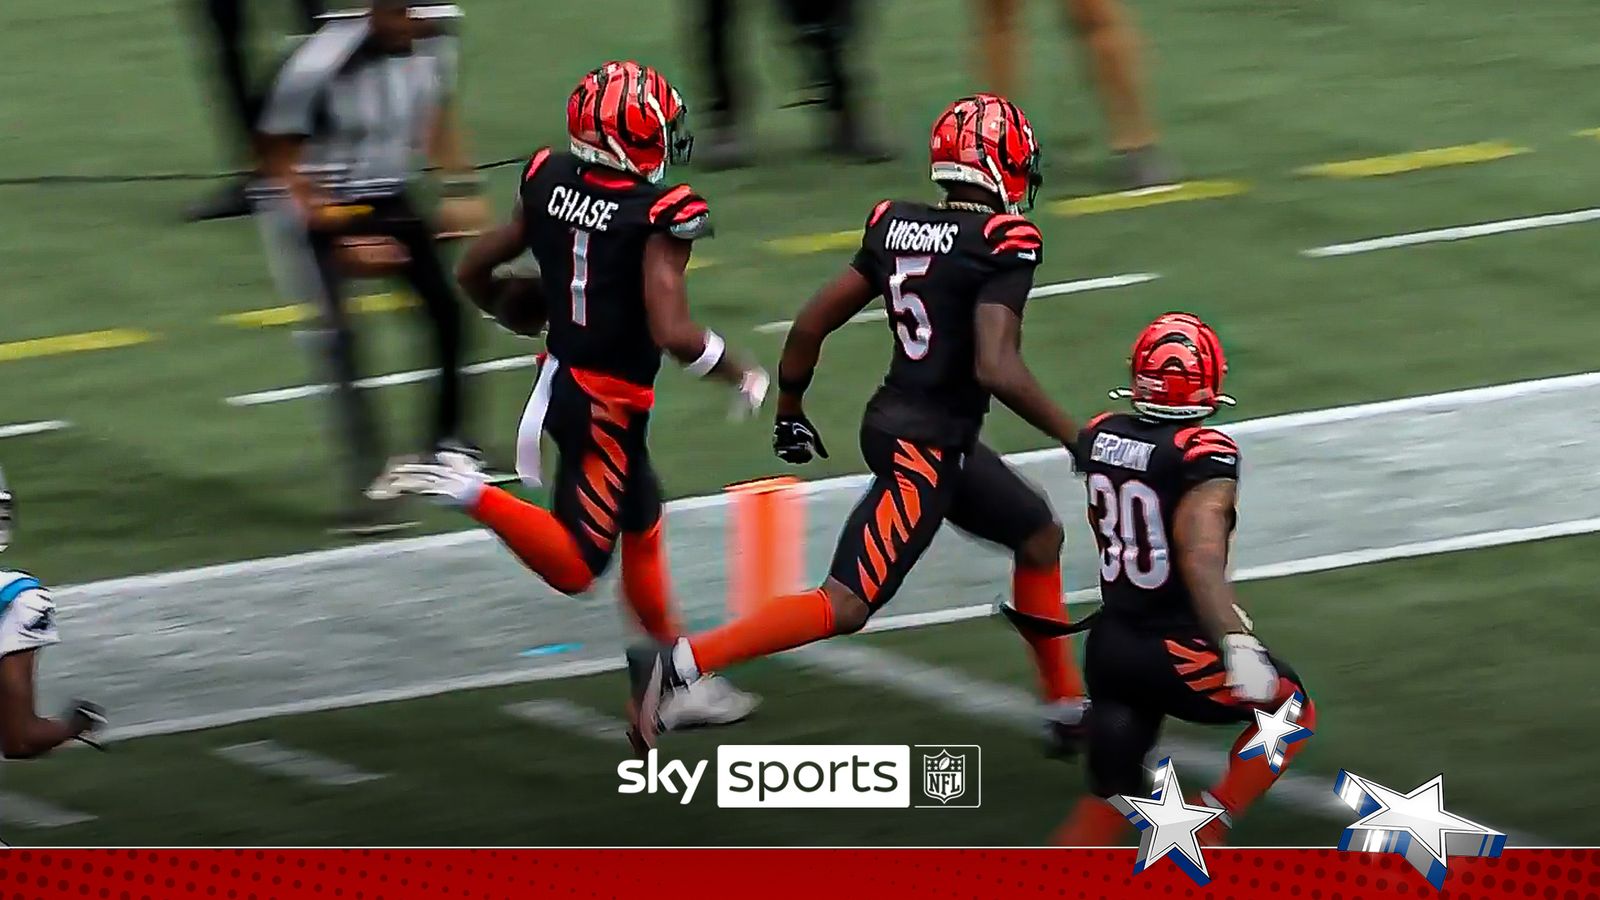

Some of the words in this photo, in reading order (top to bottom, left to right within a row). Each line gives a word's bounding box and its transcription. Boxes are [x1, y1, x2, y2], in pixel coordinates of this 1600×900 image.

[548, 186, 618, 231] CHASE
[885, 219, 958, 253] HIGGINS
[570, 228, 589, 326] 1
[889, 257, 931, 360] 5
[1088, 473, 1169, 589] 30
